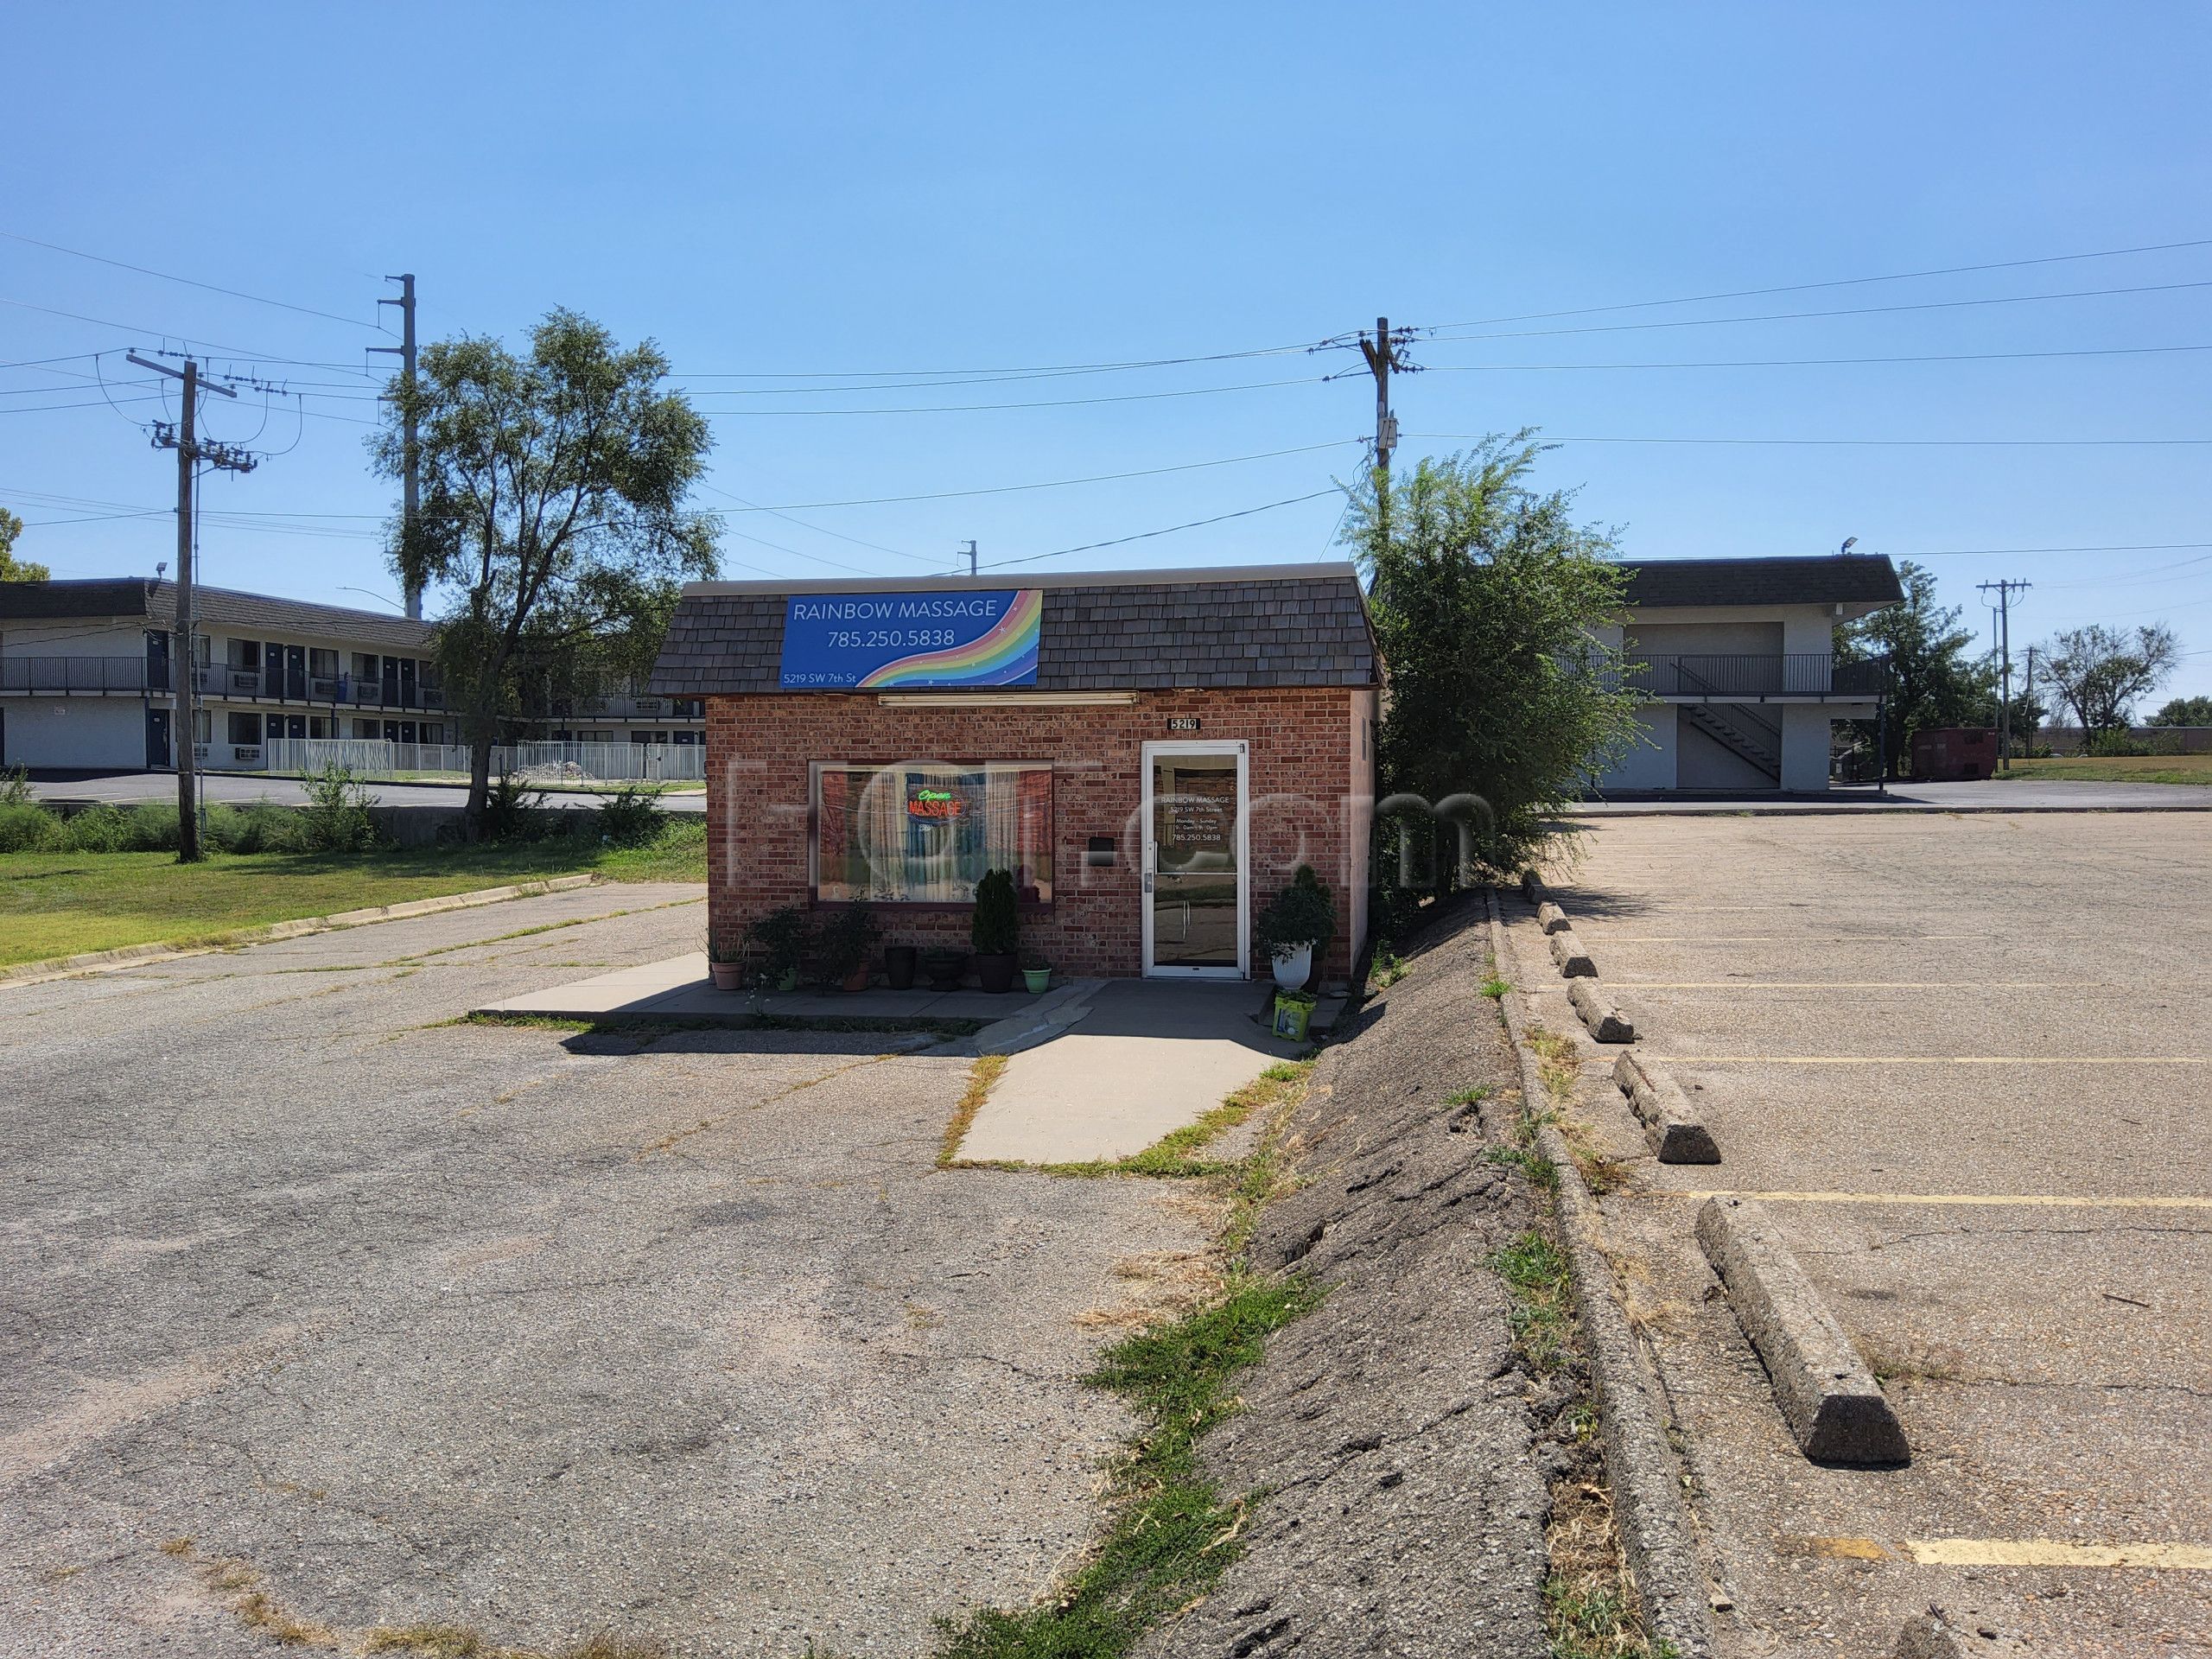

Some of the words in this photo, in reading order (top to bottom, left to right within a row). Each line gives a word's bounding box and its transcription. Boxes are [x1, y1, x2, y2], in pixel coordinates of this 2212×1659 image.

[793, 600, 893, 620] RAINBOW
[898, 599, 998, 618] MASSAGE
[827, 629, 955, 648] 785.250.5838
[783, 673, 806, 683] 5219
[808, 673, 827, 683] SW
[828, 672, 843, 683] 7th
[1172, 720, 1196, 728] 5219
[918, 790, 951, 802] Open
[909, 800, 961, 817] MASSAGE
